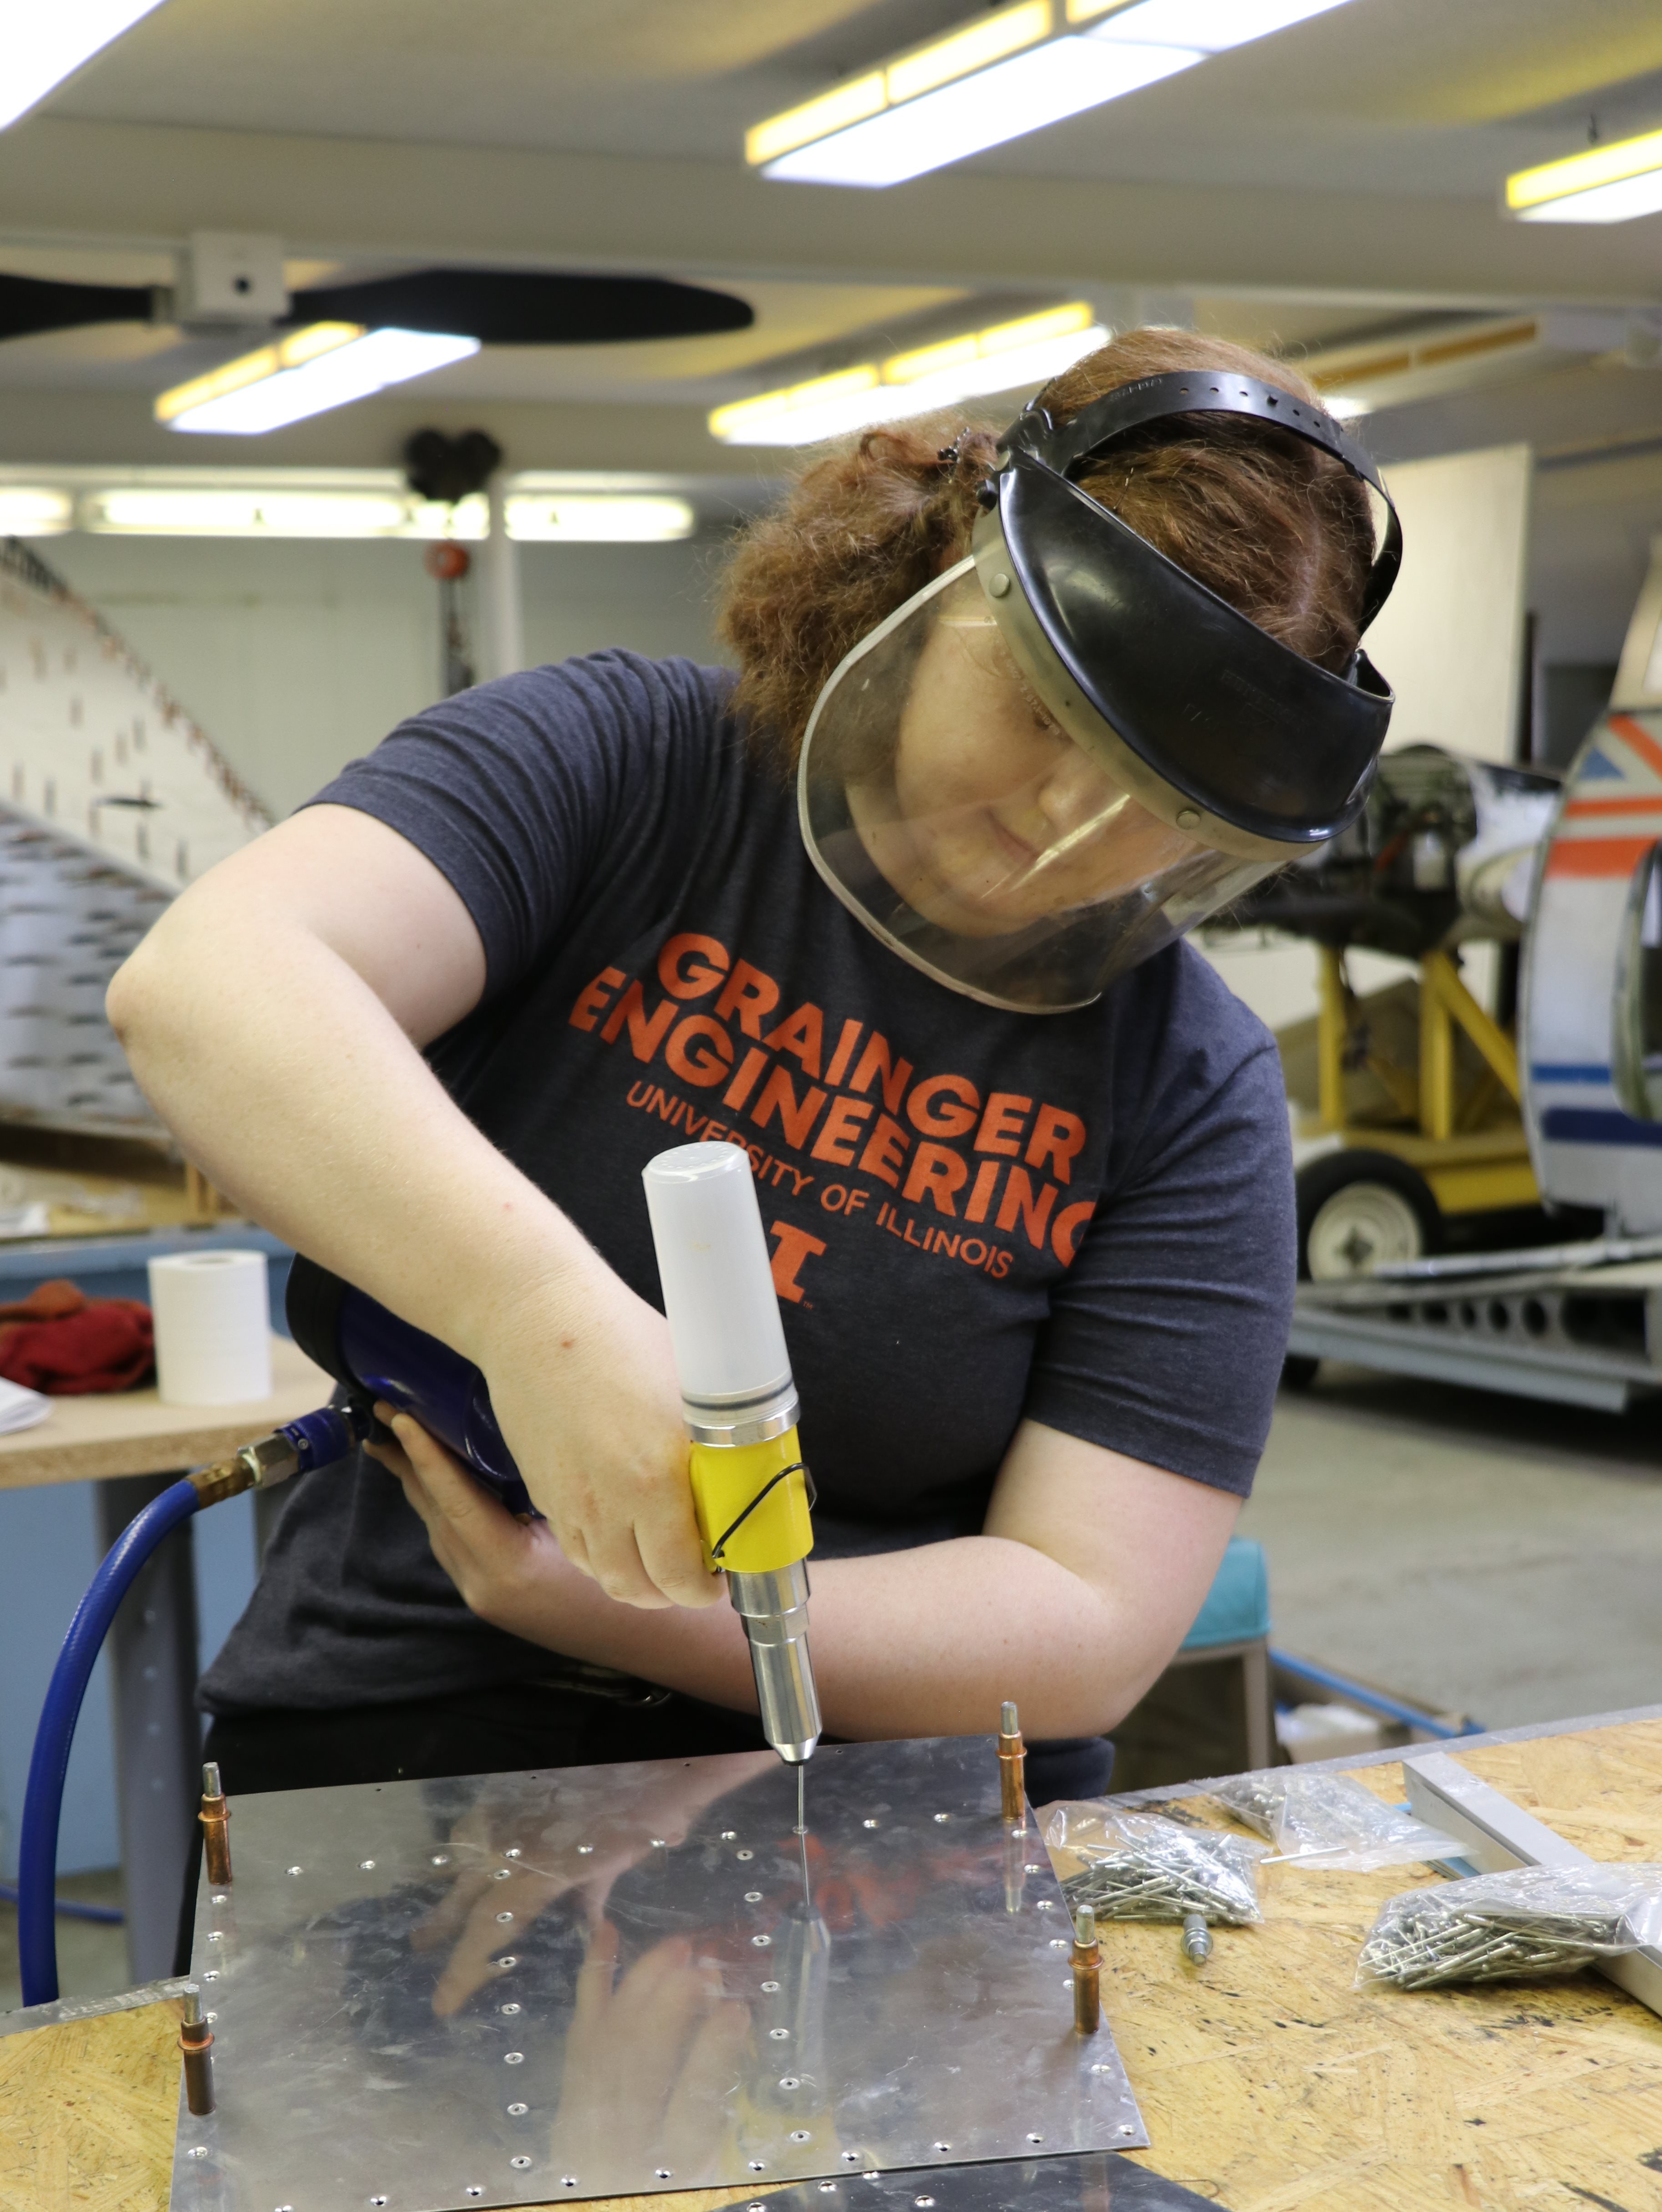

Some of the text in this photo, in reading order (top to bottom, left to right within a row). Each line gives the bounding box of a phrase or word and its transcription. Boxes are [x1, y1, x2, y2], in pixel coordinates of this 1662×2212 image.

[658, 933, 1086, 1184] GRAINGER
[821, 1184, 869, 1216] OF
[877, 1202, 1013, 1278] ILLINOIS
